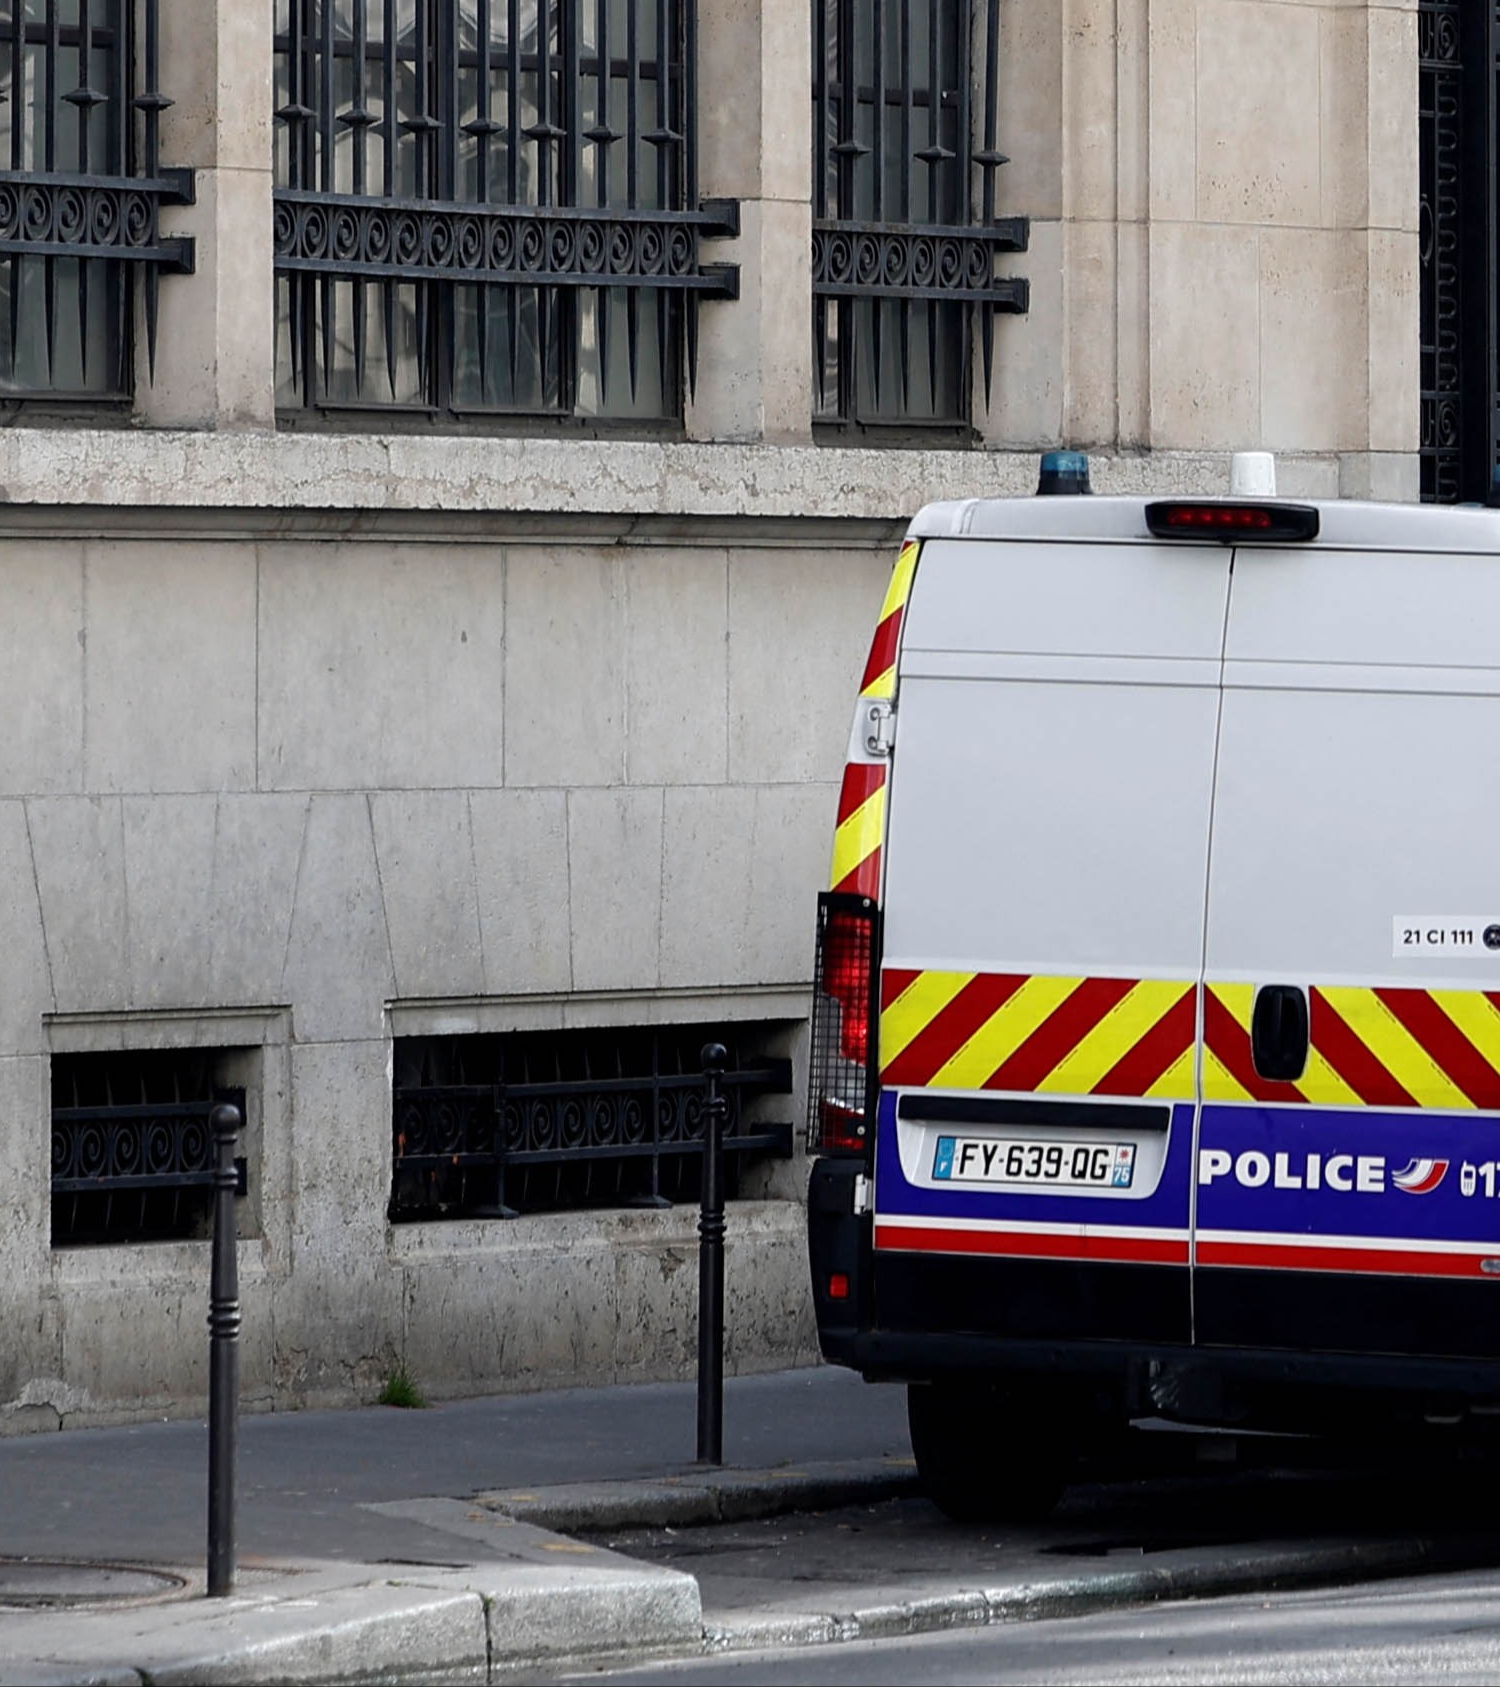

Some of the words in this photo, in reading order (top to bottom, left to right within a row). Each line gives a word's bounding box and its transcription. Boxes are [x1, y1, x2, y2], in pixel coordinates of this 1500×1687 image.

[1403, 929, 1421, 945] 21
[1426, 929, 1445, 945] CI
[1450, 929, 1473, 945] 111
[958, 1143, 1110, 1181] FY-639-QG
[1113, 1166, 1130, 1183] 75
[1198, 1149, 1385, 1193] POLICE
